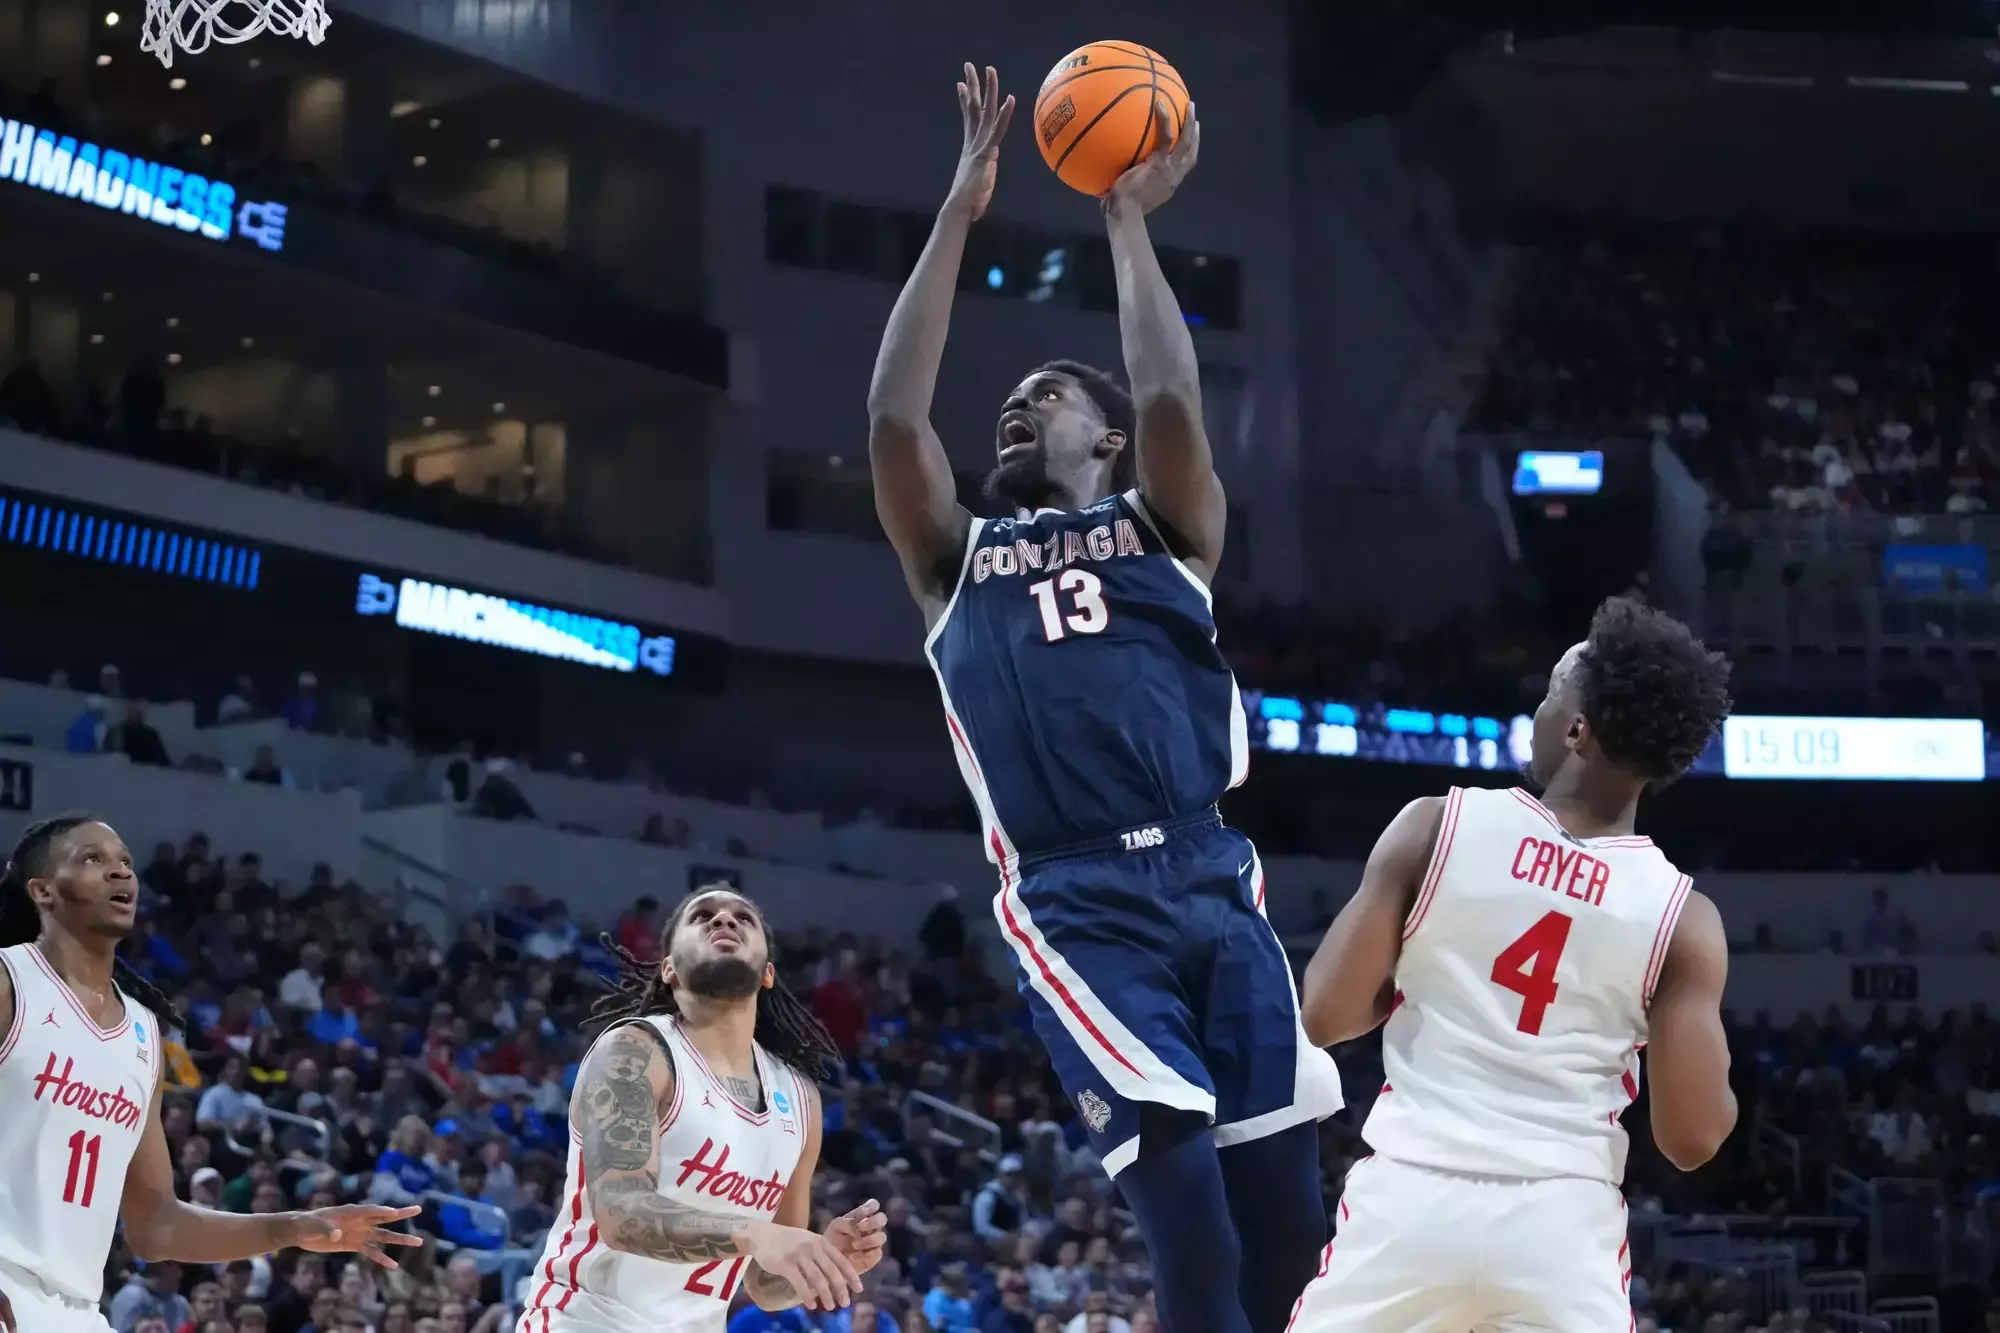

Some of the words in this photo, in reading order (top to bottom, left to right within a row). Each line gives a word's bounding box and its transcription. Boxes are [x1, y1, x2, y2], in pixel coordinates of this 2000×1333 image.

[0, 115, 236, 242] HMADNESS
[973, 518, 1145, 584] GONZAGA
[1029, 568, 1109, 643] 13
[1121, 827, 1165, 851] ZAGS
[1511, 836, 1611, 907] CRYER
[1490, 909, 1574, 1037] 4
[34, 1051, 141, 1132] Houston
[63, 1129, 102, 1208] 11
[676, 1137, 786, 1213] Housto
